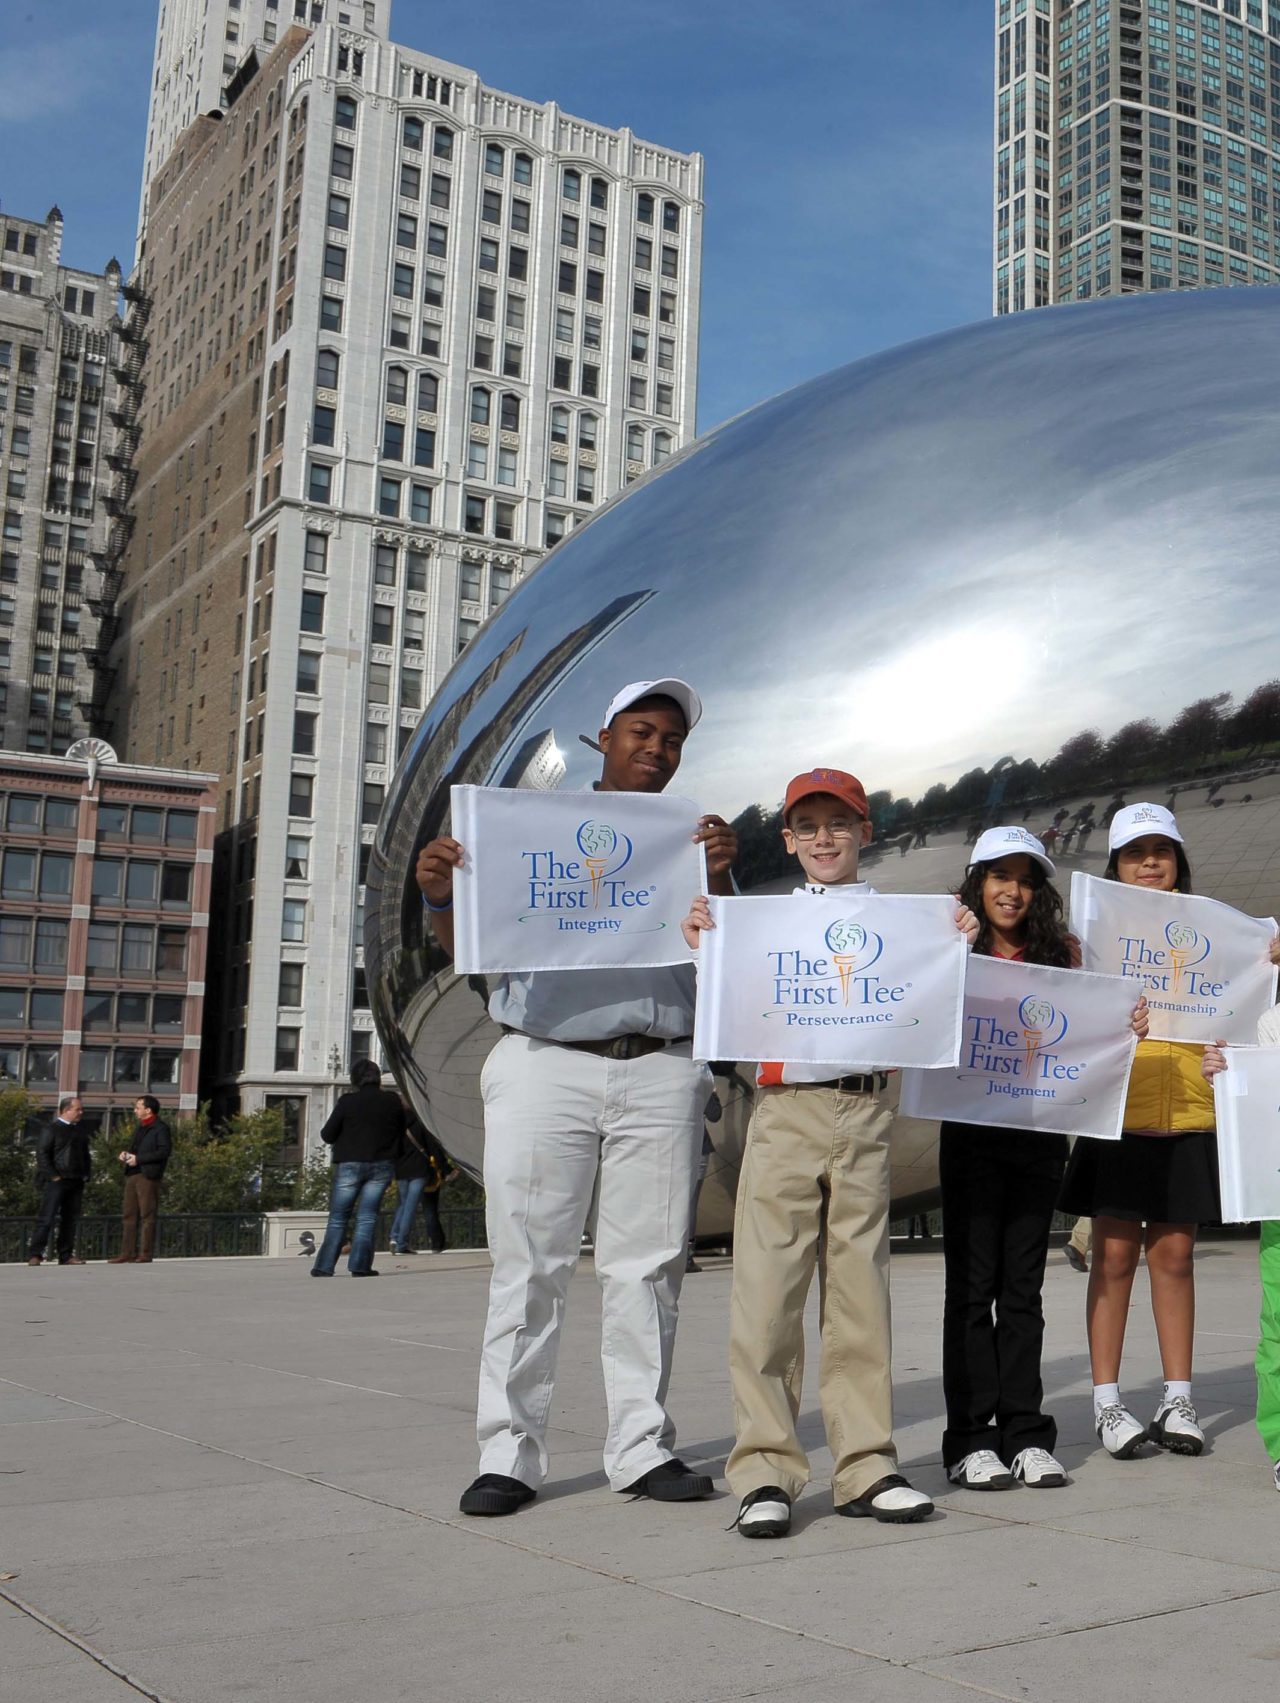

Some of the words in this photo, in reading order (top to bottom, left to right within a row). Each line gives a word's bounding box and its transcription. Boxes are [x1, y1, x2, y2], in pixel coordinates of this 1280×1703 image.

[521, 850, 580, 880] The
[527, 882, 588, 908] First
[558, 917, 622, 934] Integrity
[767, 950, 828, 976] The
[1118, 936, 1166, 966] The
[773, 978, 838, 1004] First
[786, 1012, 894, 1026] Perseverance
[1148, 1000, 1217, 1016] rtsmanship
[967, 1015, 1018, 1047] The
[967, 1043, 1022, 1075] First
[986, 1080, 1056, 1098] Judgment
